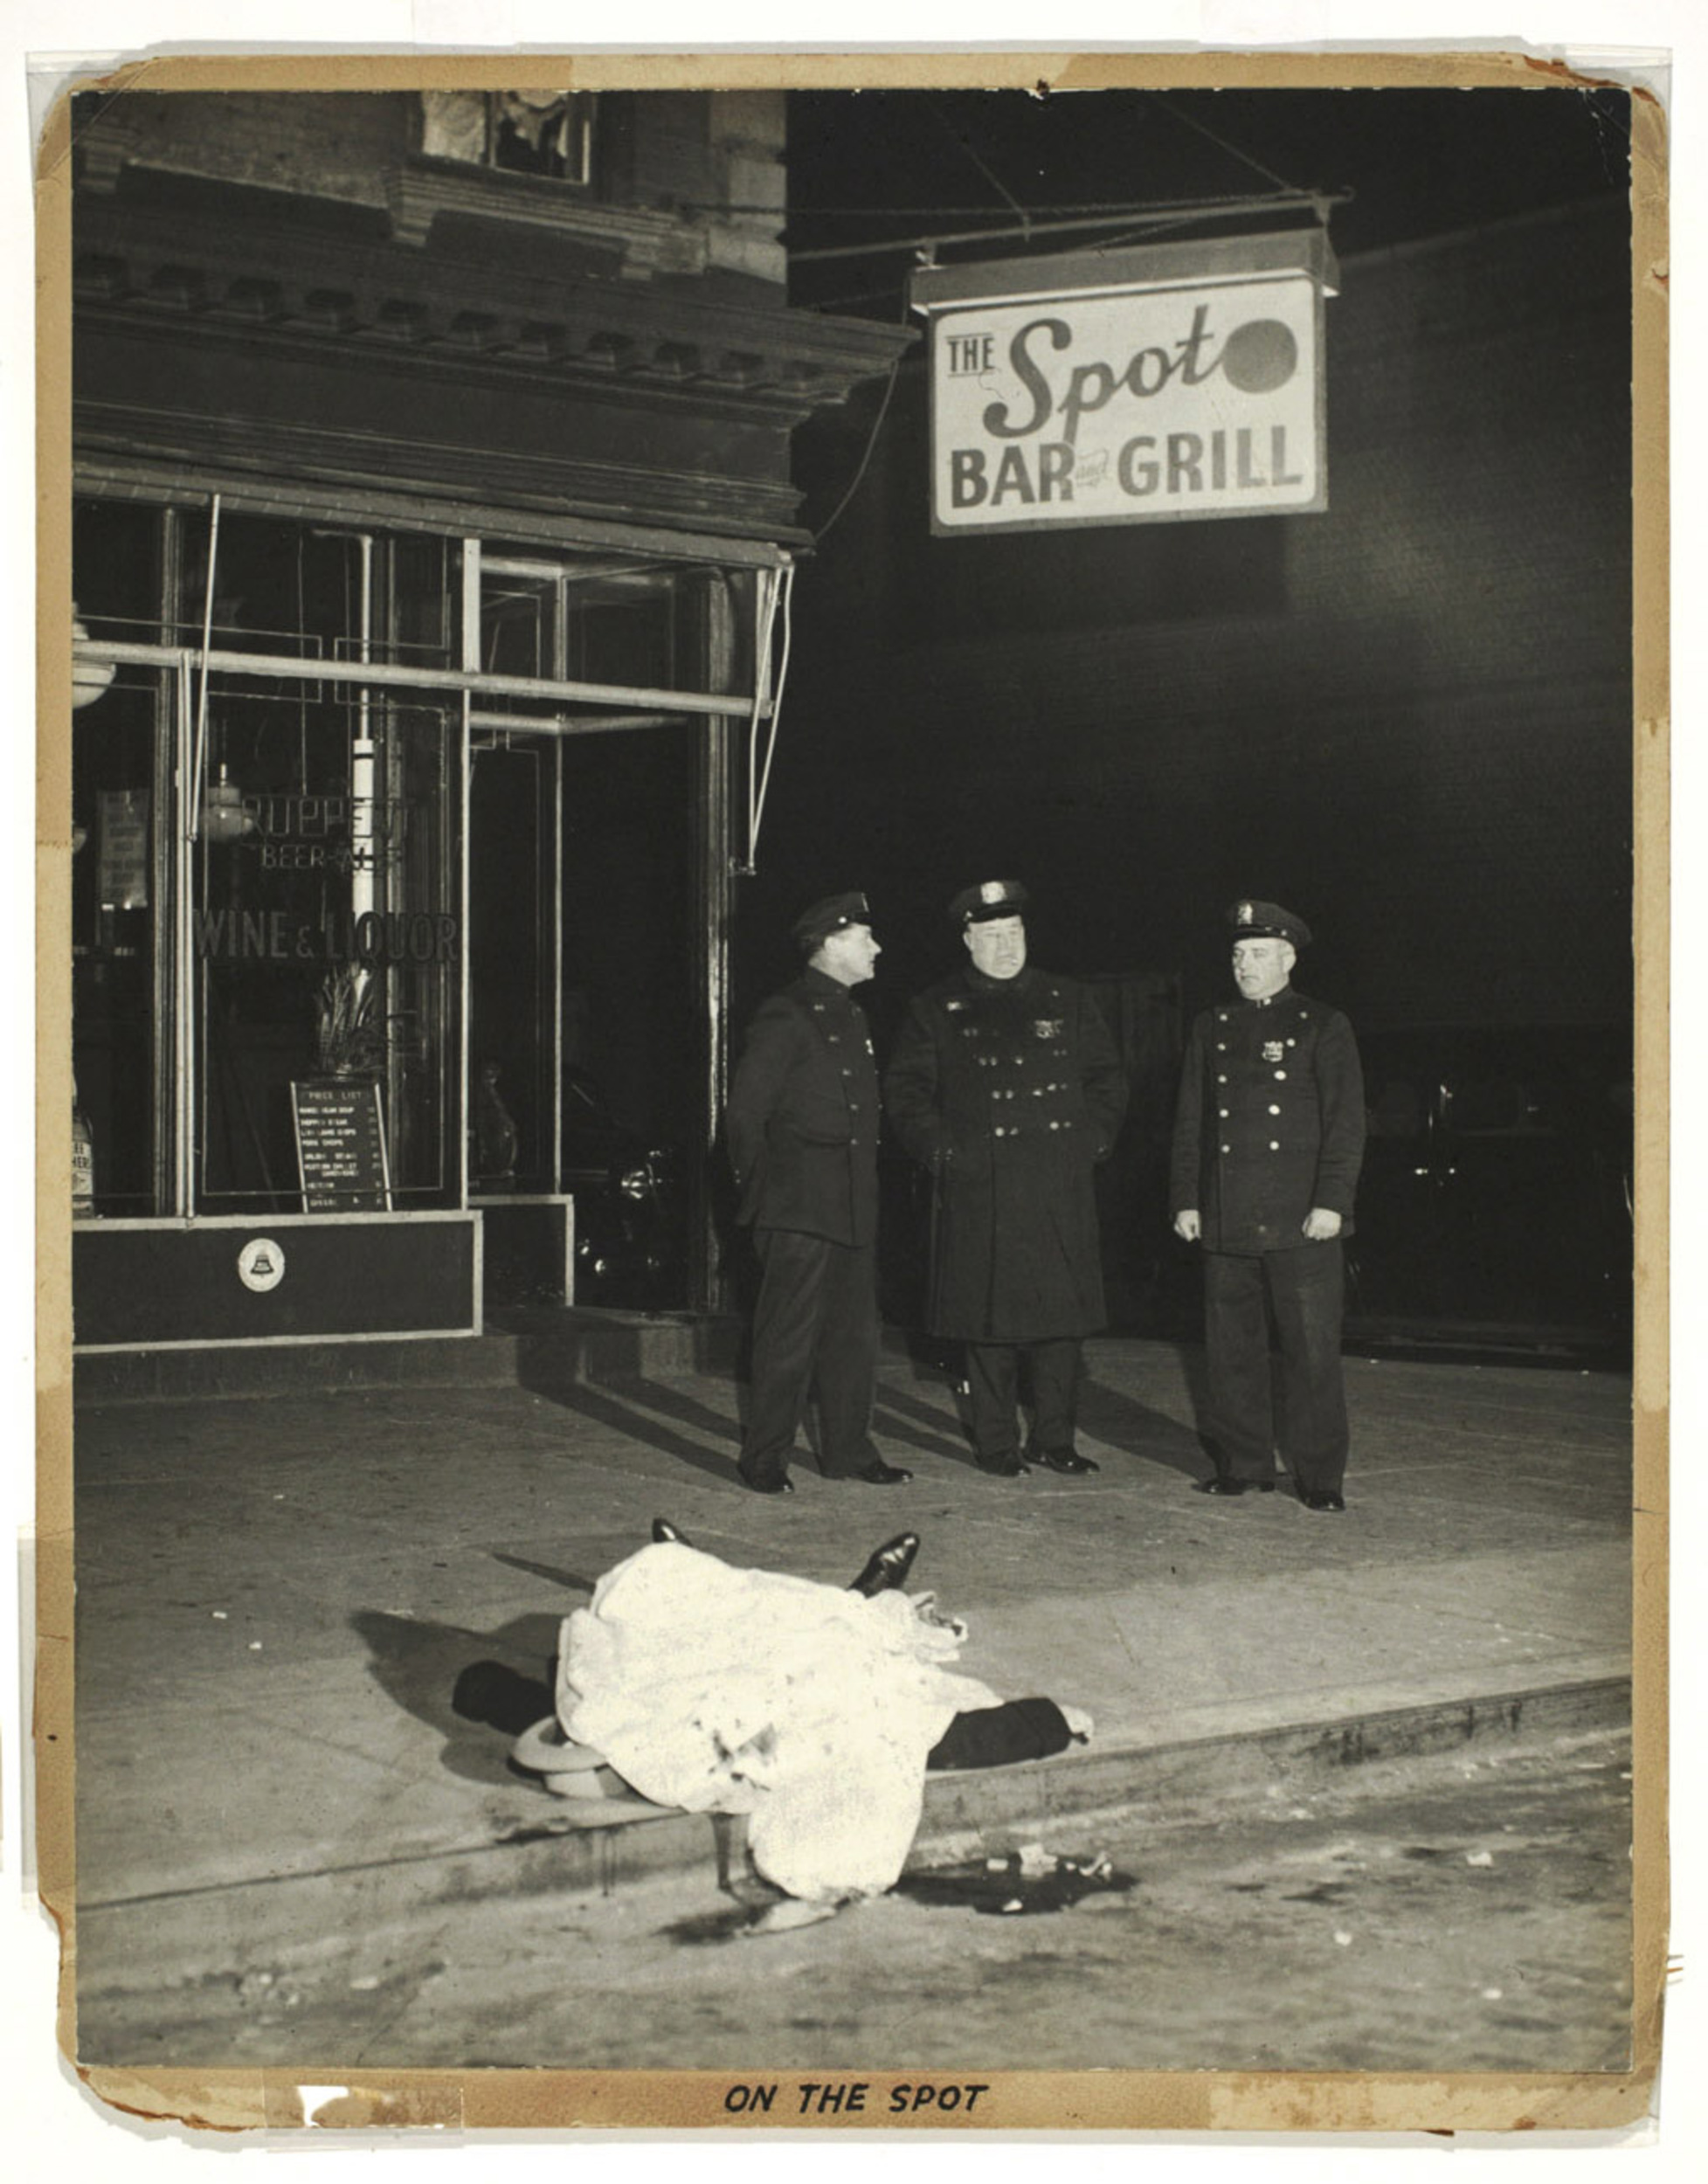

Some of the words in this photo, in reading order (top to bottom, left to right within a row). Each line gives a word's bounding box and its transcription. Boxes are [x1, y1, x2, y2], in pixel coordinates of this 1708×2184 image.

[947, 337, 994, 372] THE
[983, 304, 1220, 446] Spot
[951, 443, 1075, 508] BAR
[1117, 425, 1303, 497] GRILL
[194, 909, 288, 958] WINE
[295, 926, 315, 958] &
[326, 910, 457, 964] LIQUOR
[724, 2084, 778, 2112] ON
[799, 2084, 869, 2113] THE
[889, 2084, 990, 2112] SPOT
